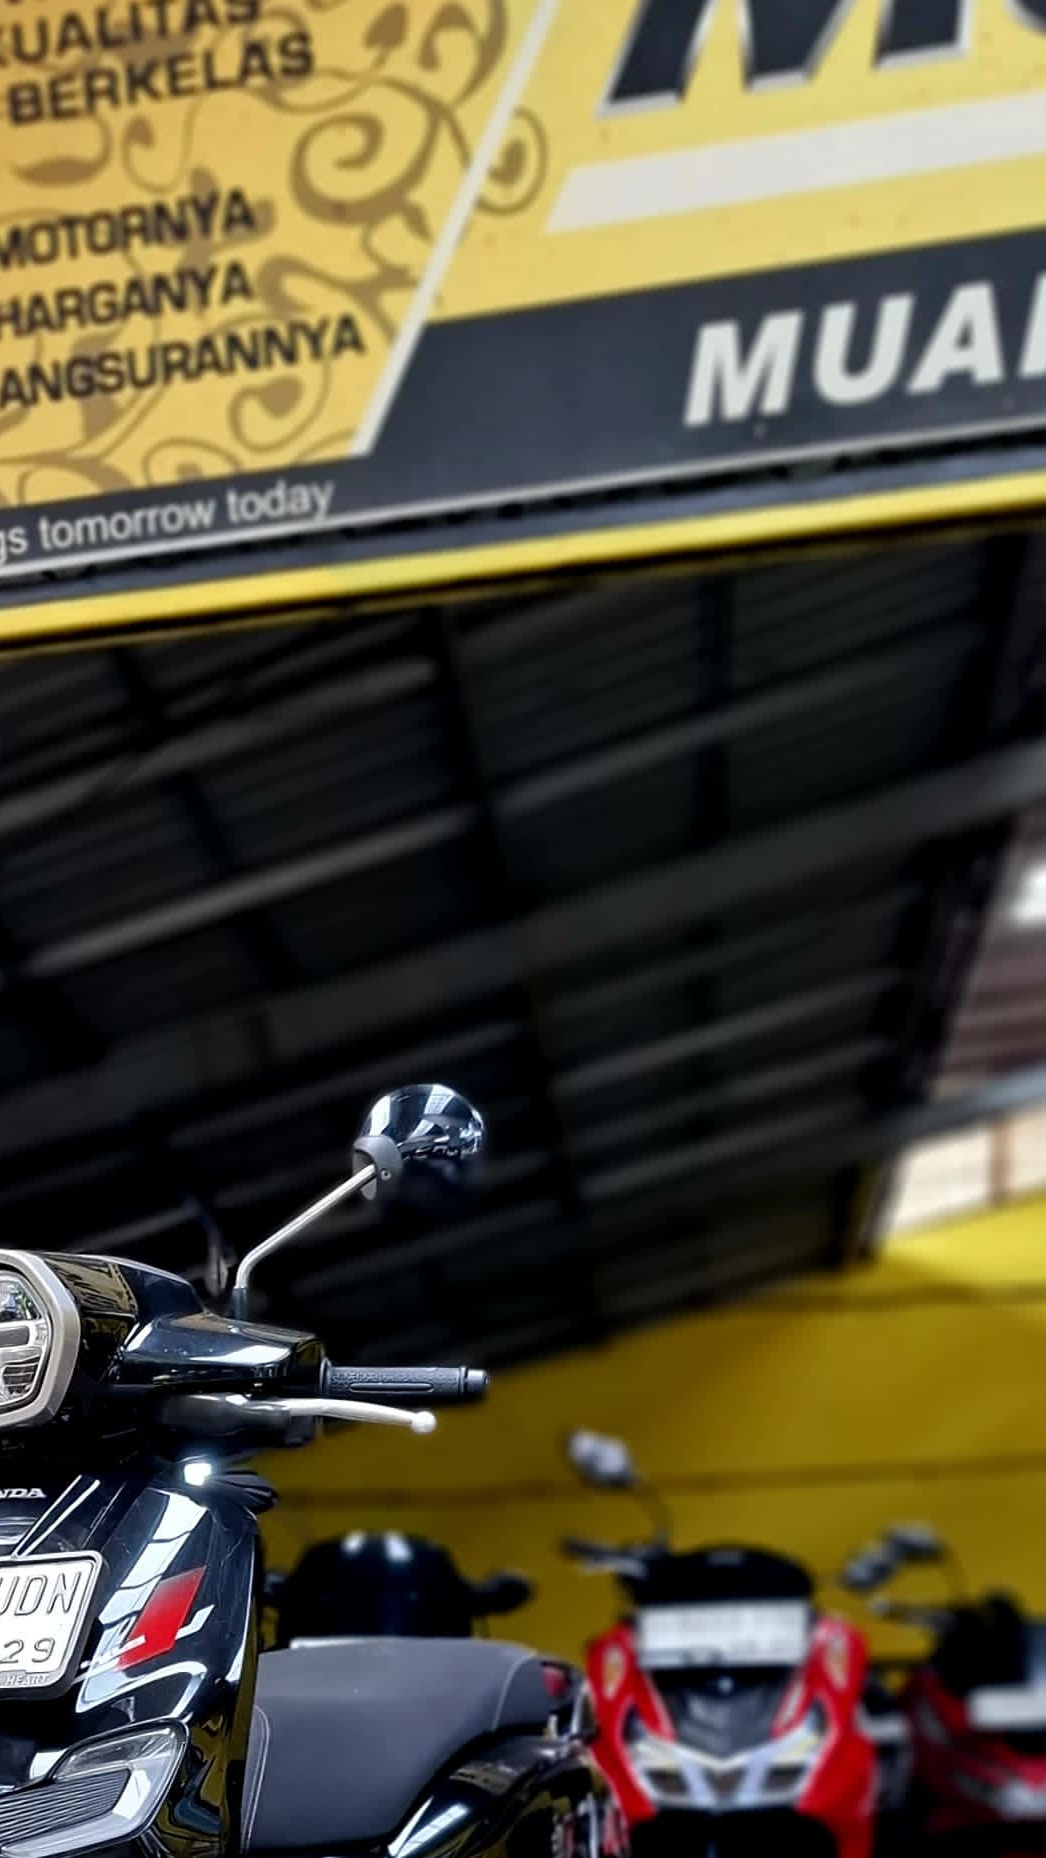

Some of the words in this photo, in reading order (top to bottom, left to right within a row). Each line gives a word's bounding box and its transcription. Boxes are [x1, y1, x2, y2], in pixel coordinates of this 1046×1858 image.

[8, 31, 314, 125] BERKELAS
[39, 496, 215, 551] tomorrow
[227, 480, 334, 528] today
